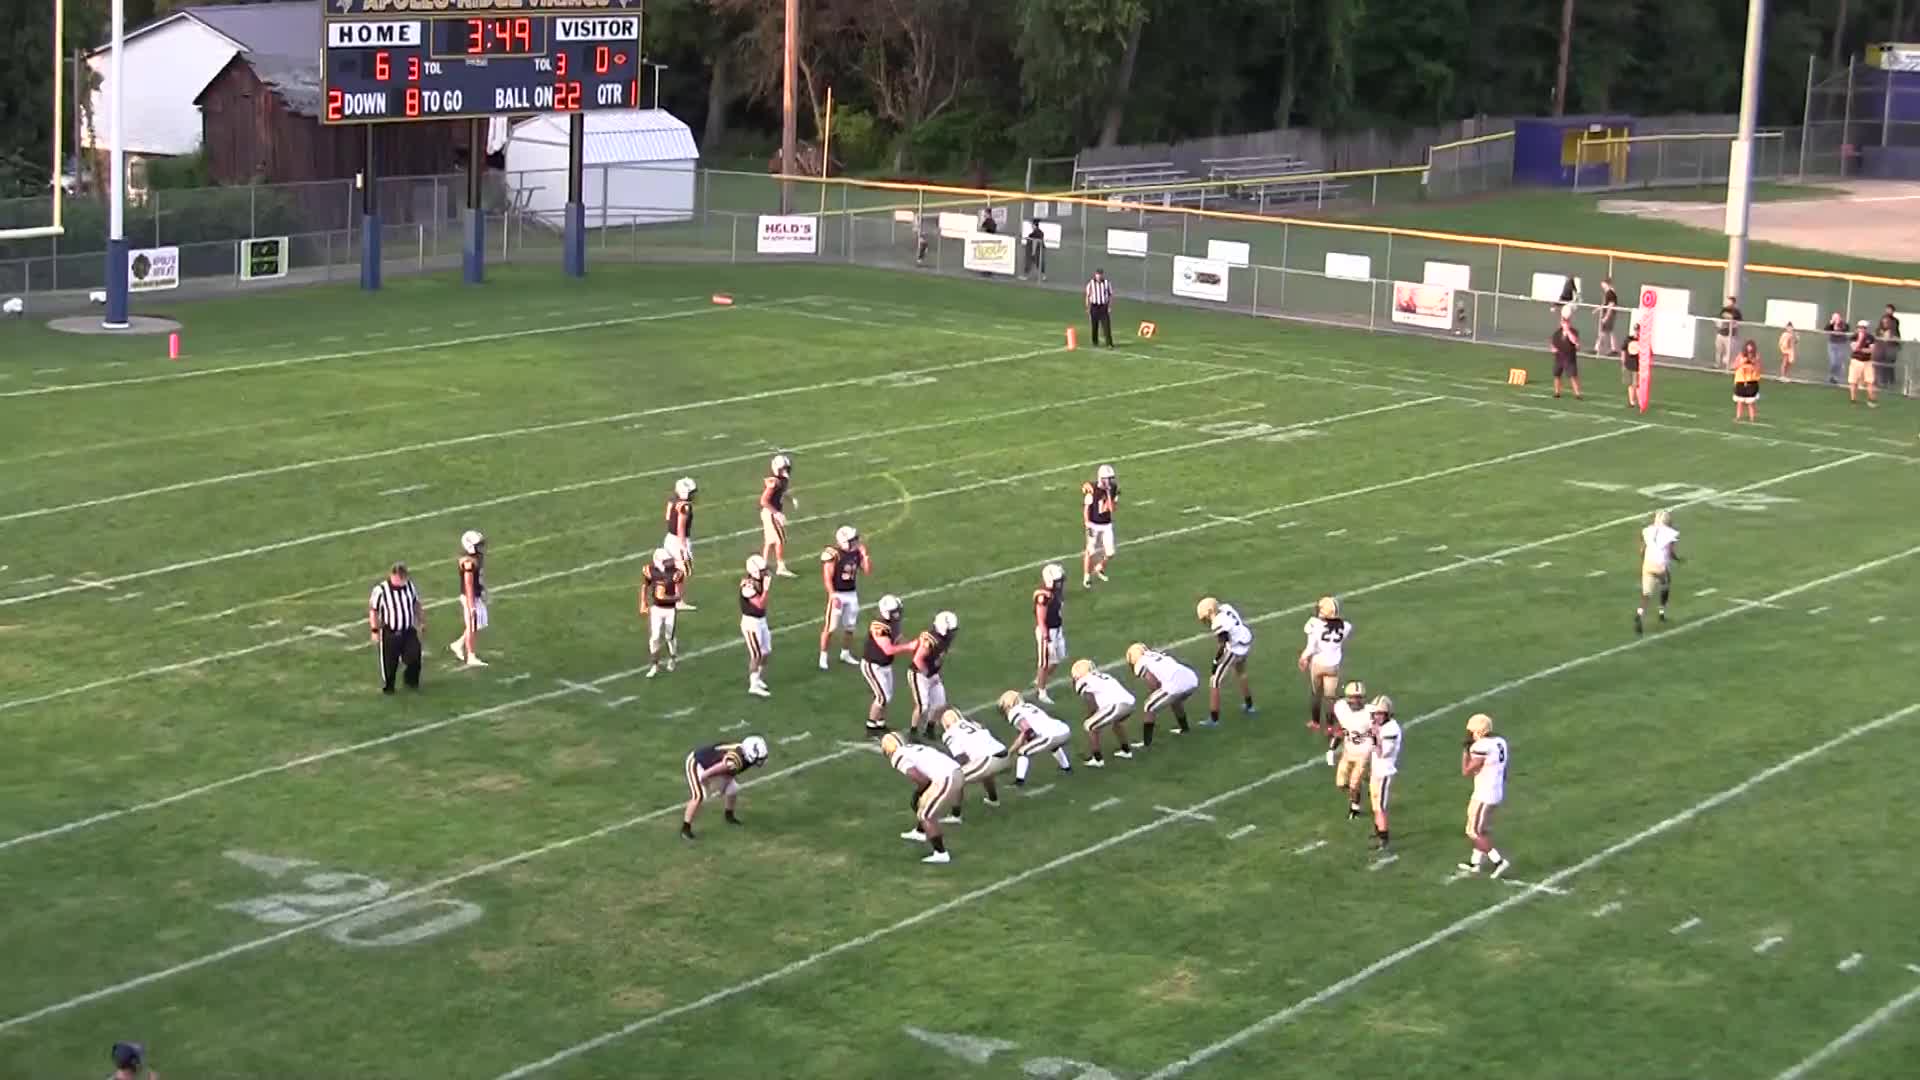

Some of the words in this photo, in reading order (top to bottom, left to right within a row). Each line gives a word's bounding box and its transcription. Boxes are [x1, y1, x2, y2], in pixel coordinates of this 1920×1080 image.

[338, 24, 411, 43] HOME
[467, 18, 530, 53] 3:49
[560, 20, 634, 37] VISITOR
[375, 52, 390, 81] 6
[407, 57, 419, 81] 3
[423, 62, 443, 75] TOL
[534, 58, 552, 71] TOL
[555, 53, 567, 75] 3
[595, 46, 609, 73] 0
[328, 90, 343, 119] 2
[344, 92, 386, 116] DOWN
[405, 88, 419, 117] 8
[422, 91, 440, 112] TO
[443, 89, 463, 112] GO
[495, 87, 530, 109] BALL
[534, 85, 553, 107] ON
[554, 82, 581, 109] 22
[597, 83, 623, 105] QTR
